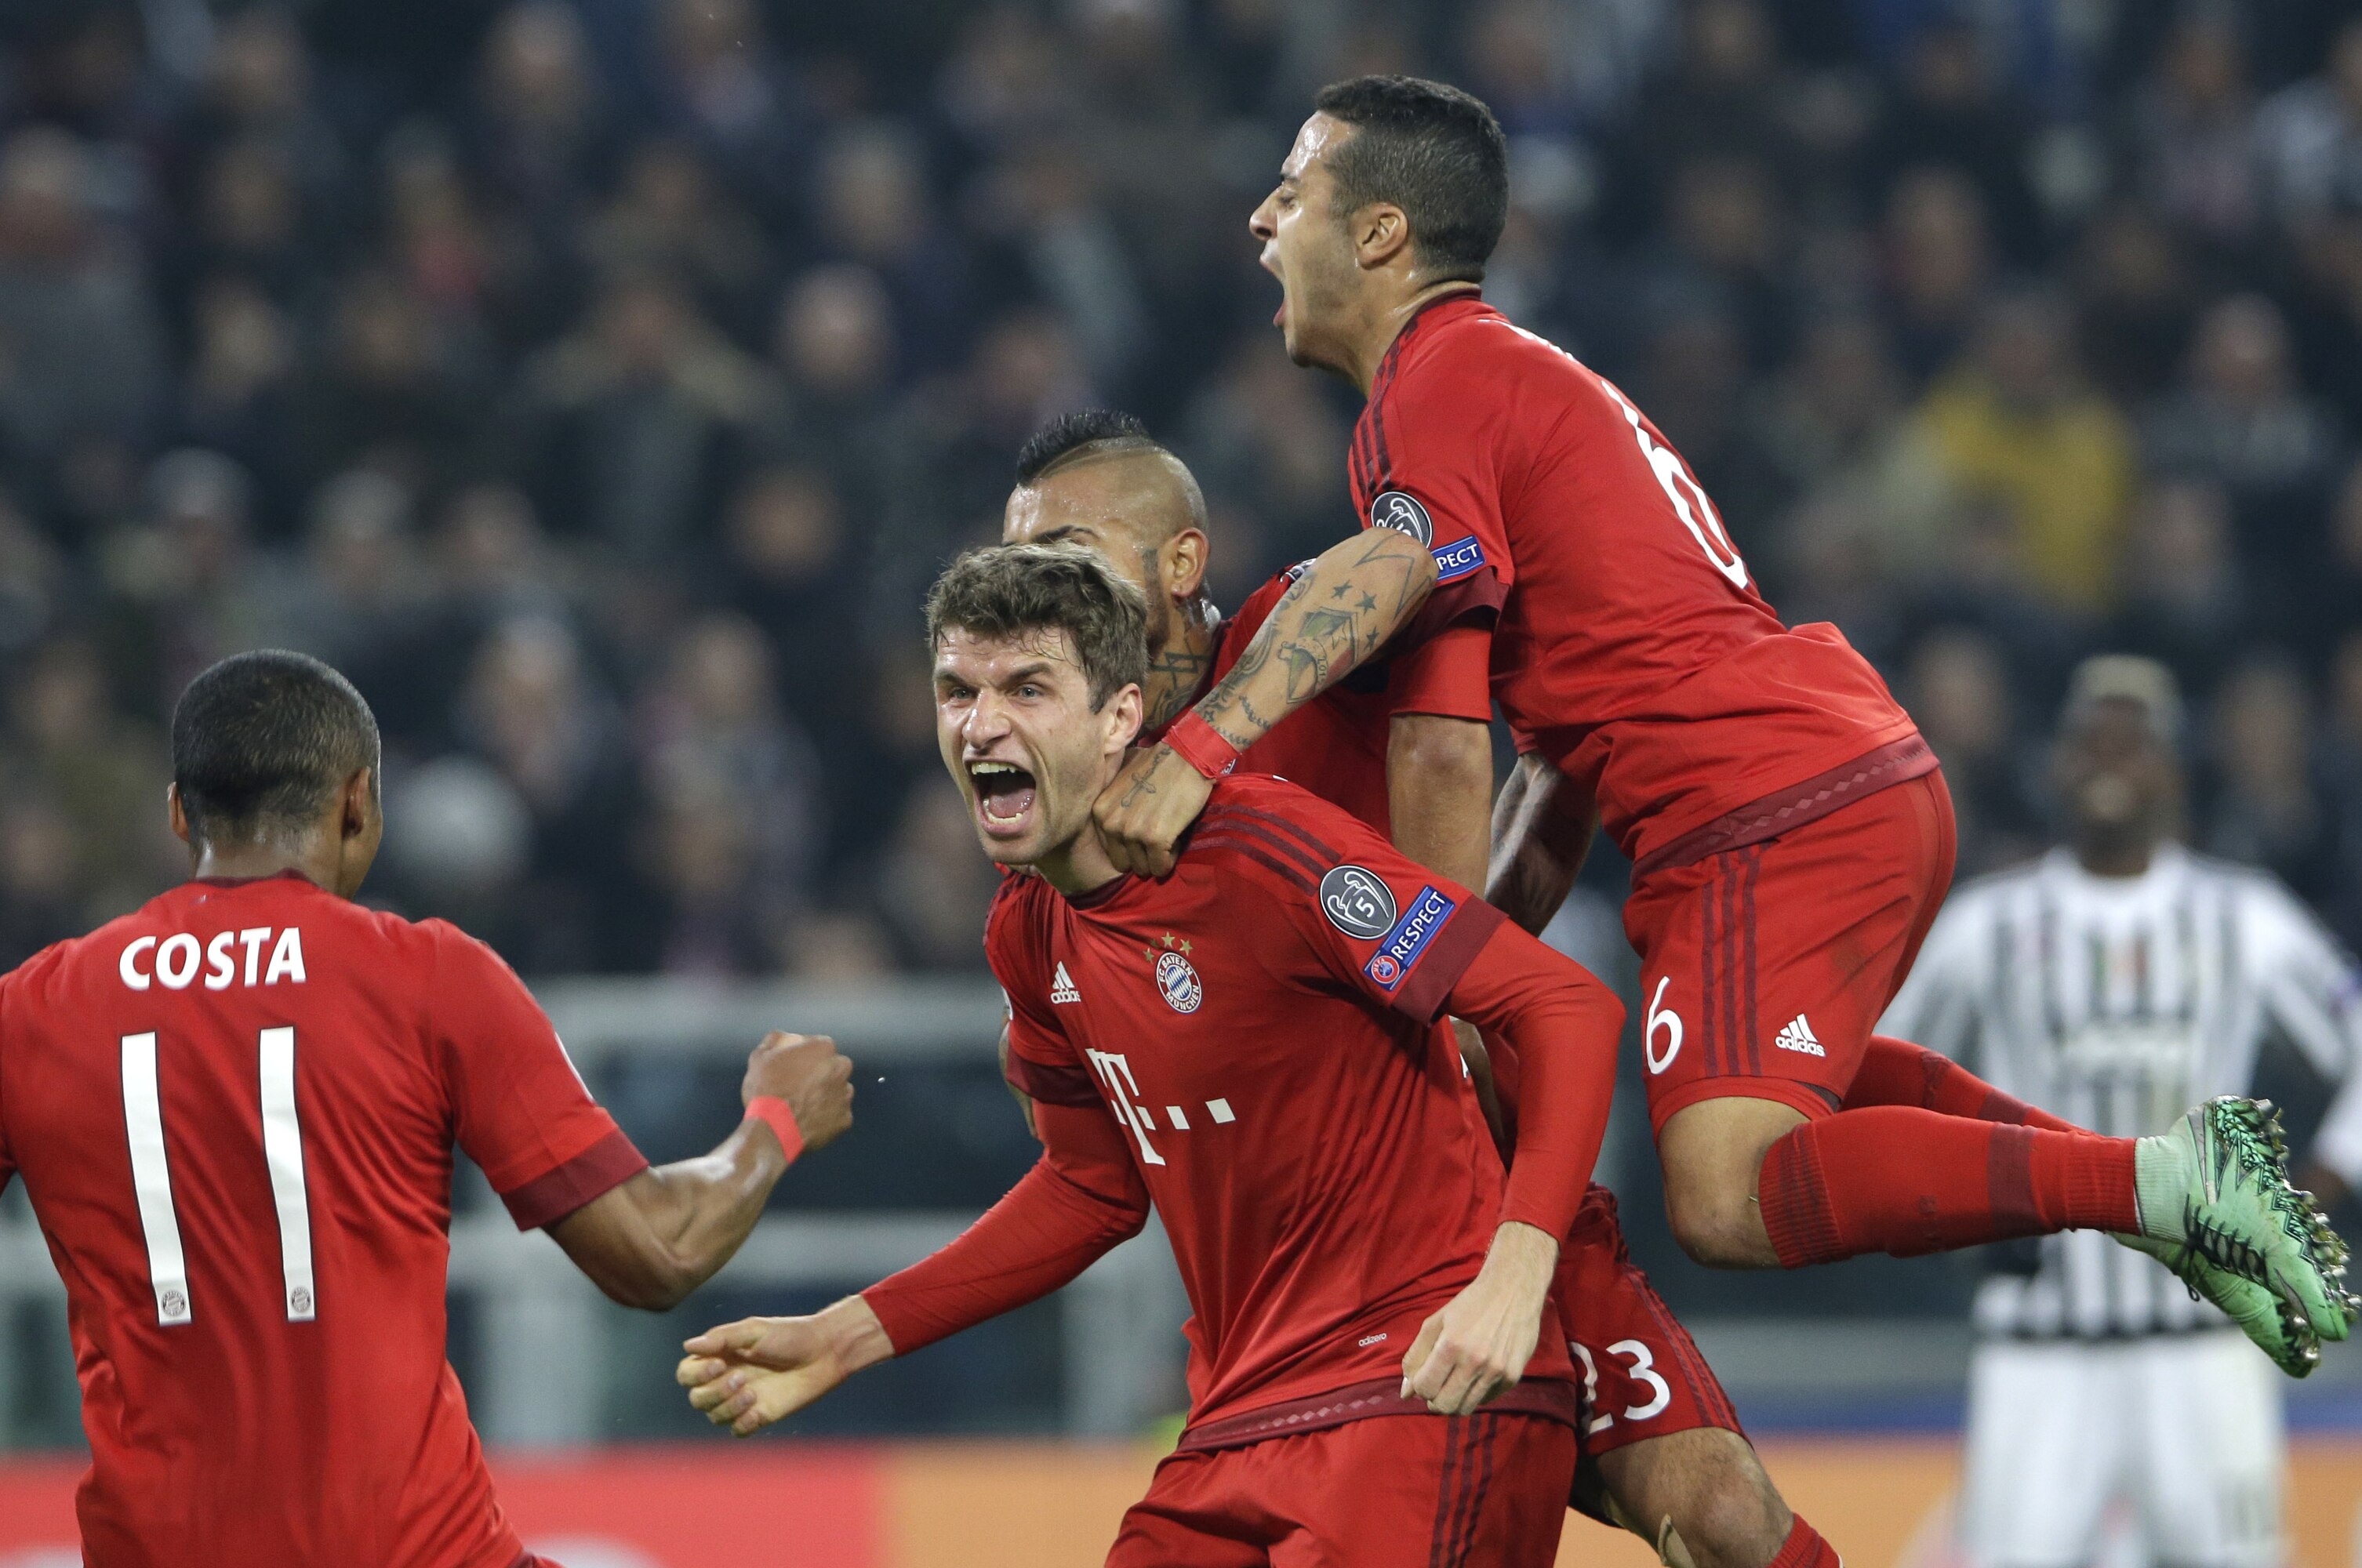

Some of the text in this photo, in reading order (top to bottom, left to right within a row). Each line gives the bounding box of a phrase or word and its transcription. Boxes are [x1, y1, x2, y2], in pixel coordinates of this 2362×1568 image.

[1355, 896, 1375, 918] 5
[1390, 891, 1445, 960] RESPECT
[119, 926, 307, 992] COSTA
[1161, 956, 1193, 976] BAYERN
[1646, 975, 1684, 1075] 6
[1774, 1035, 1826, 1058] adidas
[121, 1026, 315, 1325] 11
